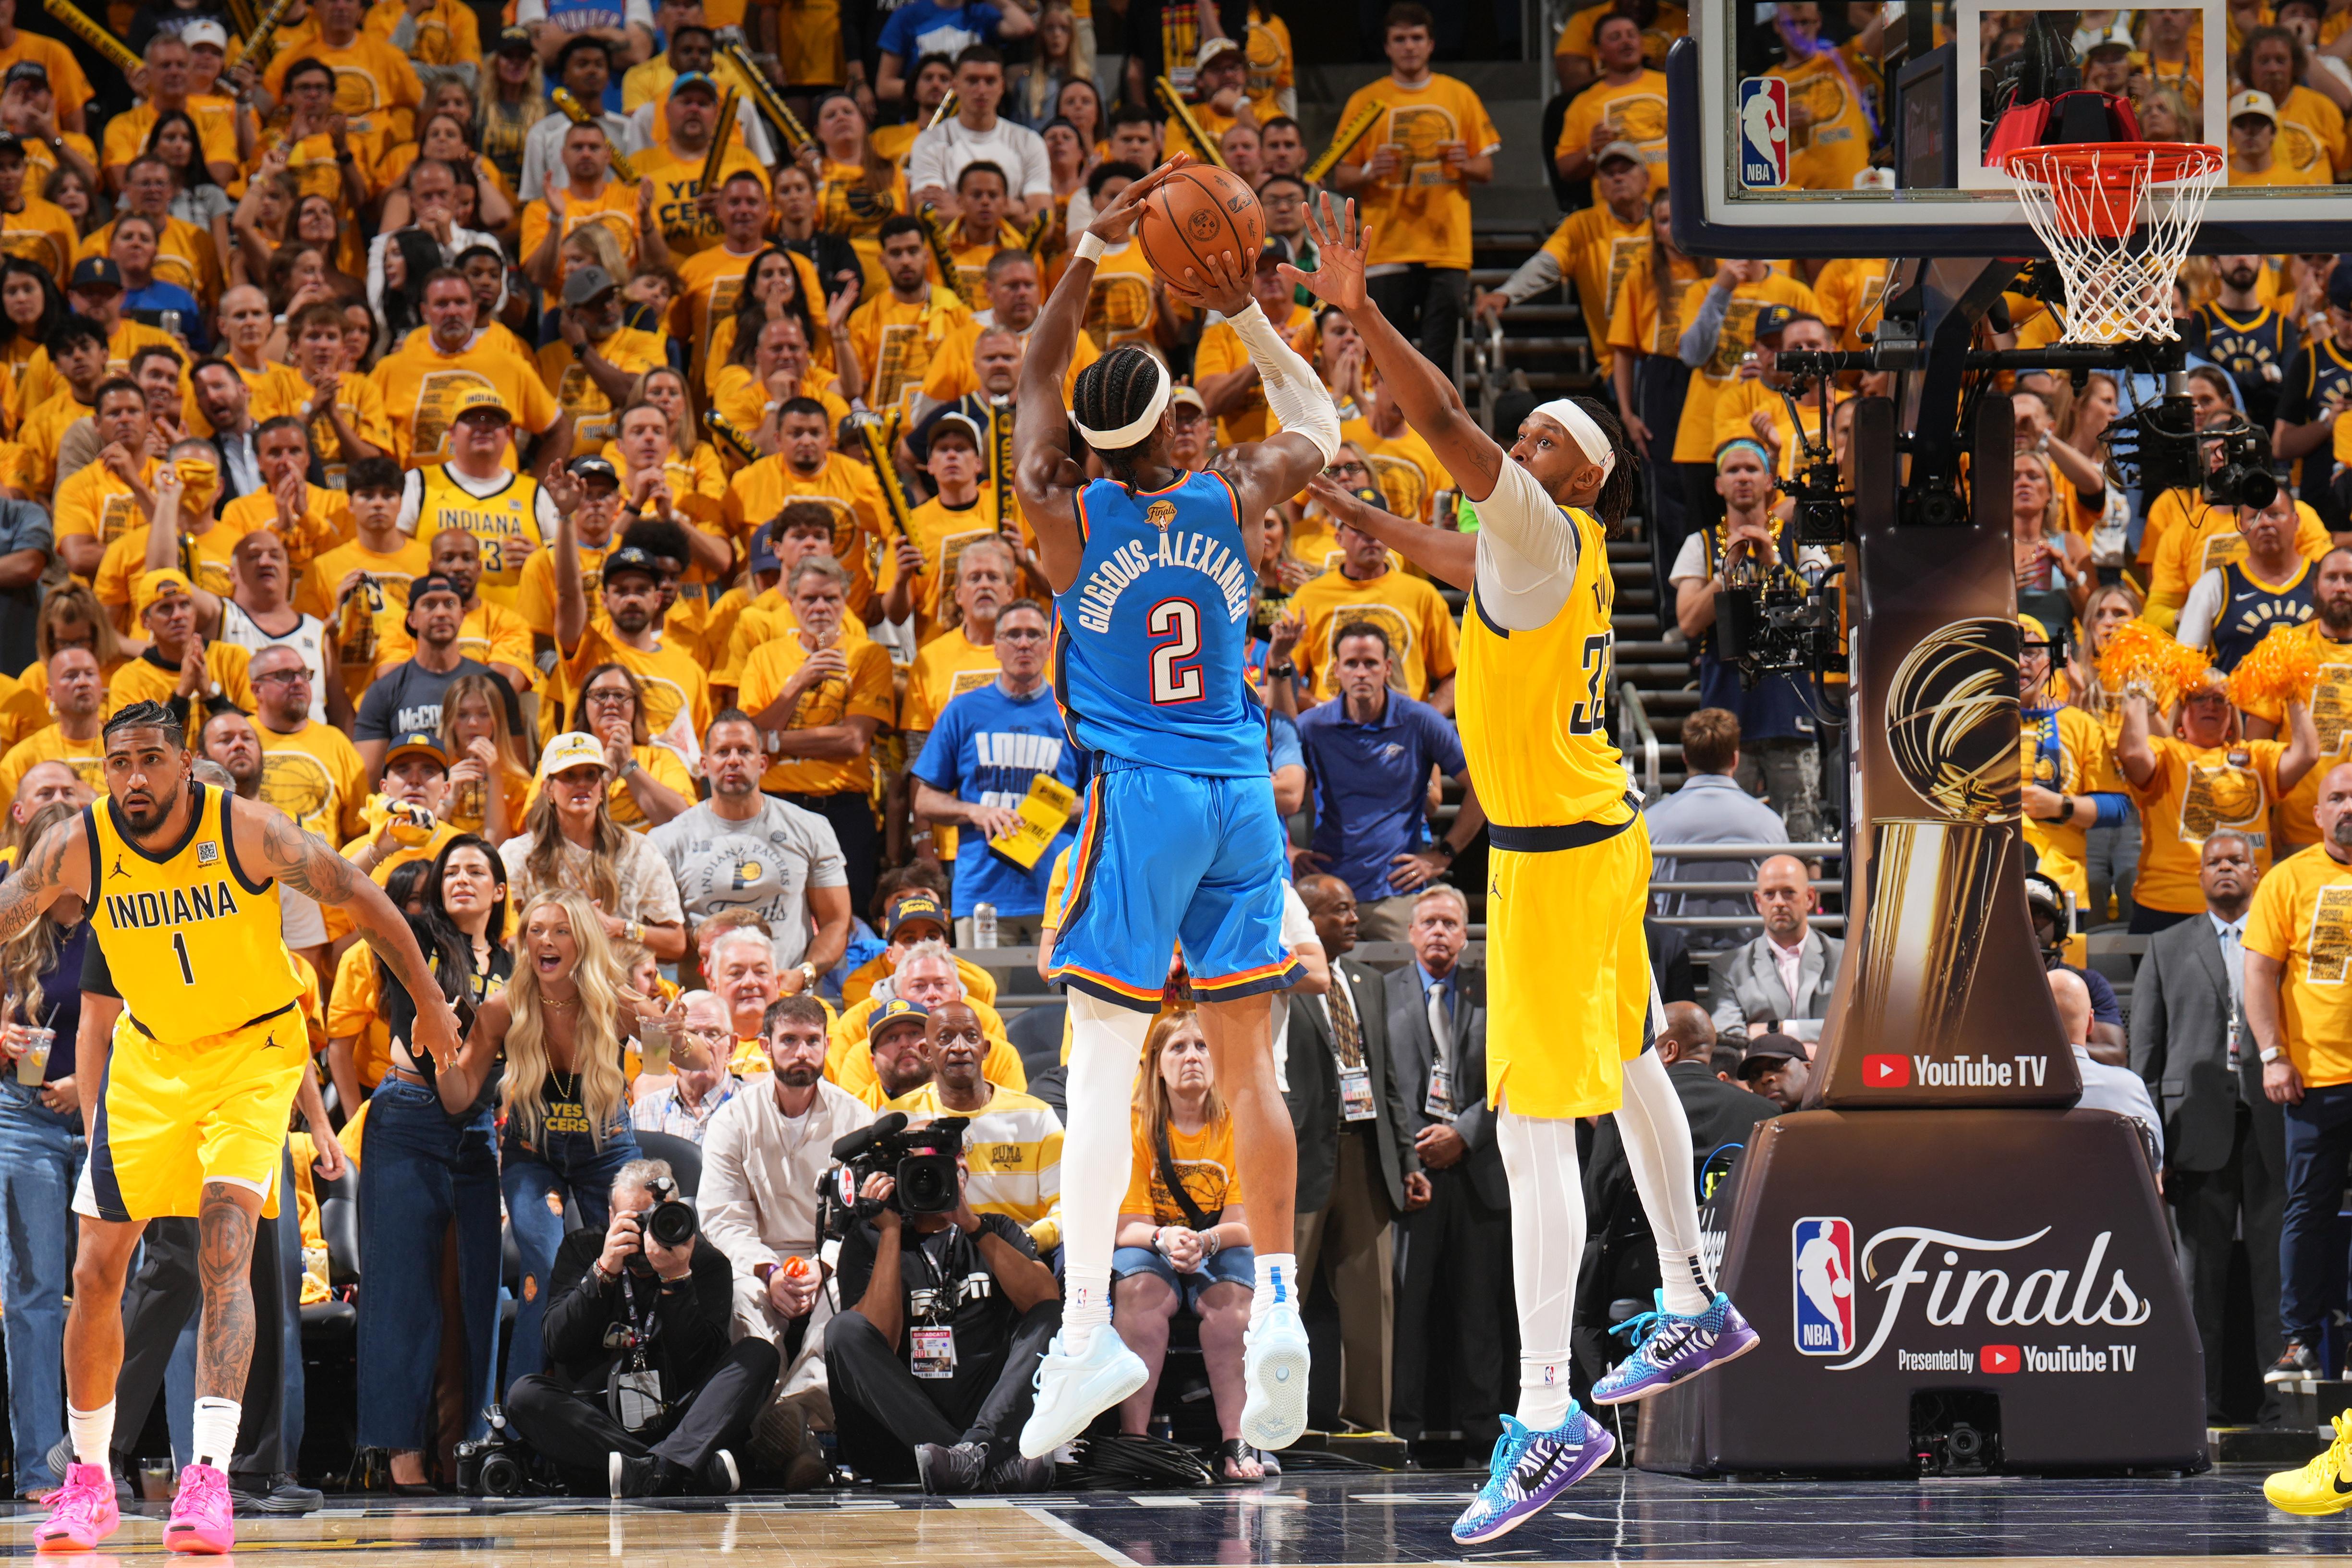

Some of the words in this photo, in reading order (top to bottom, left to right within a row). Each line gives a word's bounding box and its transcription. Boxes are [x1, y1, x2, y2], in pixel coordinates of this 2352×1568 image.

[1747, 164, 1770, 181] NBA
[438, 510, 523, 535] INDIANA
[1146, 504, 1176, 523] Finals
[1078, 531, 1247, 634] GILGEOUS-ALEXANDER
[2236, 600, 2314, 635] INDIAN
[1146, 596, 1206, 706] 2
[555, 748, 600, 760] Pacers
[975, 731, 1063, 771] LOUD
[1024, 821, 1050, 840] FINALS
[197, 861, 222, 869] spokenote
[702, 845, 746, 895] INDIANA
[752, 843, 790, 886] PACERS
[105, 880, 239, 930] INDIANA
[171, 931, 195, 986] 1
[1913, 1054, 2012, 1086] YouTube
[2014, 1056, 2047, 1086] TV
[550, 1103, 583, 1117] YES
[542, 1117, 590, 1132] 'CERS
[992, 1144, 1021, 1161] PUMA
[1825, 1226, 2152, 1371] Finals
[1804, 1325, 1832, 1346] NBA
[1899, 1349, 1958, 1371] Presented
[1960, 1349, 1974, 1374] by
[2023, 1345, 2107, 1372] YouTube
[2108, 1345, 2136, 1372] TV
